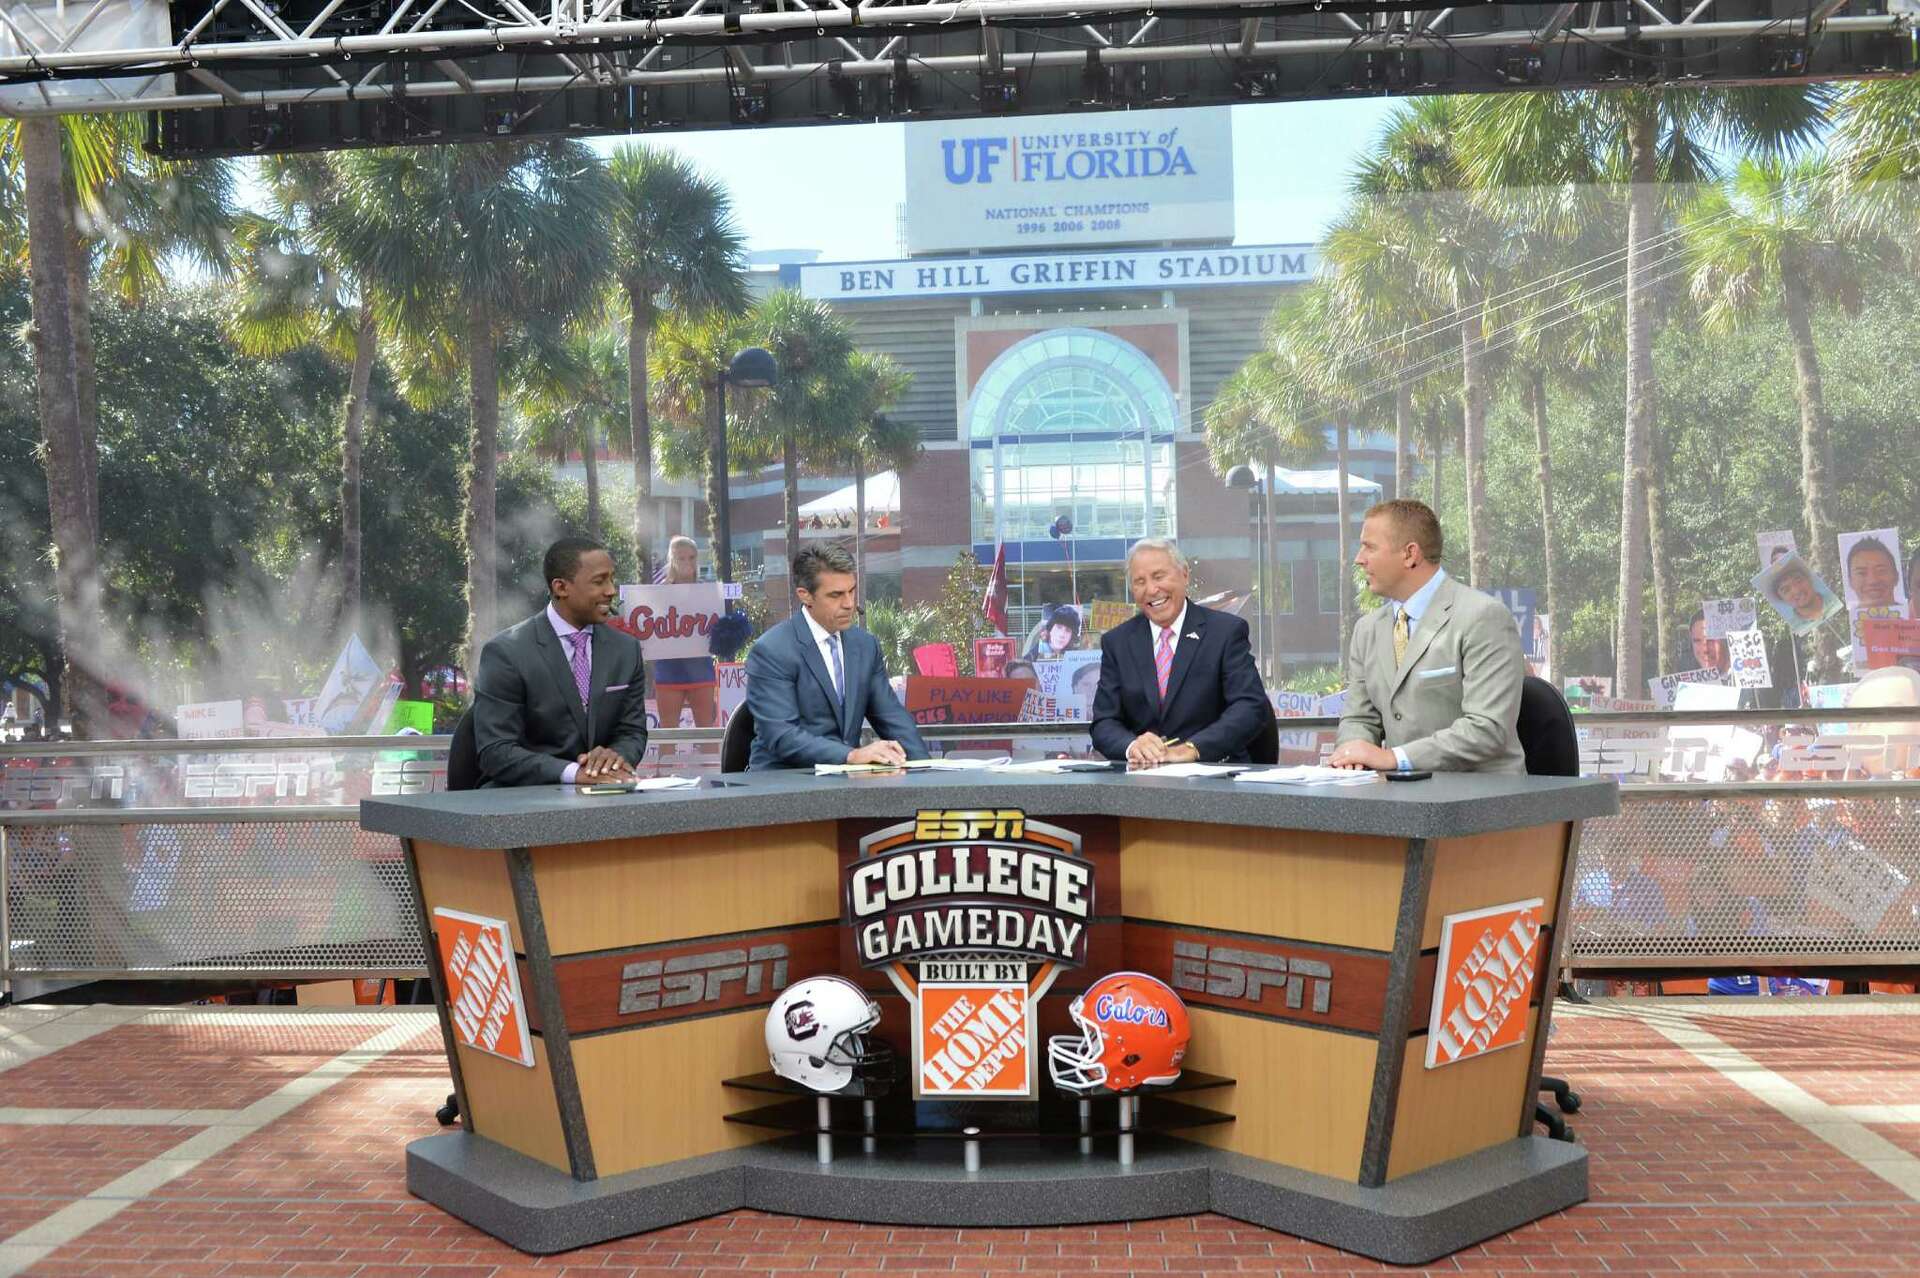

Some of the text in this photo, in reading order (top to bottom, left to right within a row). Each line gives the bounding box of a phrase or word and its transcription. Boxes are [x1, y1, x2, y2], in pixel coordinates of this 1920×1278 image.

[940, 136, 1008, 185] UF
[1021, 127, 1179, 150] UNIVERSITY of
[1021, 145, 1198, 183] FLORIDA
[985, 201, 1150, 221] NATIONAL CHAMPIONS
[1016, 219, 1121, 234] 1996 2006 2008
[839, 253, 1307, 292] BEN HILL GRIFFIN STADIUM
[930, 687, 1014, 705] PLAY LIKE
[183, 763, 310, 798] ESPN
[915, 809, 1025, 840] ESPN
[852, 847, 1090, 918] COLLEGE
[449, 928, 473, 981] THE
[862, 908, 1083, 961] GAMEDAY
[1453, 927, 1499, 990] THE
[454, 925, 507, 1045] HOME
[618, 942, 790, 1016] ESPN
[925, 963, 1023, 981] BUILT BY
[1172, 940, 1333, 1014] ESPN
[1438, 907, 1541, 1060] HOME
[480, 975, 513, 1052] DEPOT
[929, 994, 977, 1041] THE
[1095, 993, 1169, 1028] Gators
[1470, 955, 1534, 1054] DEPOT
[922, 987, 1026, 1092] HOME
[963, 1025, 1026, 1092] DEPOT
